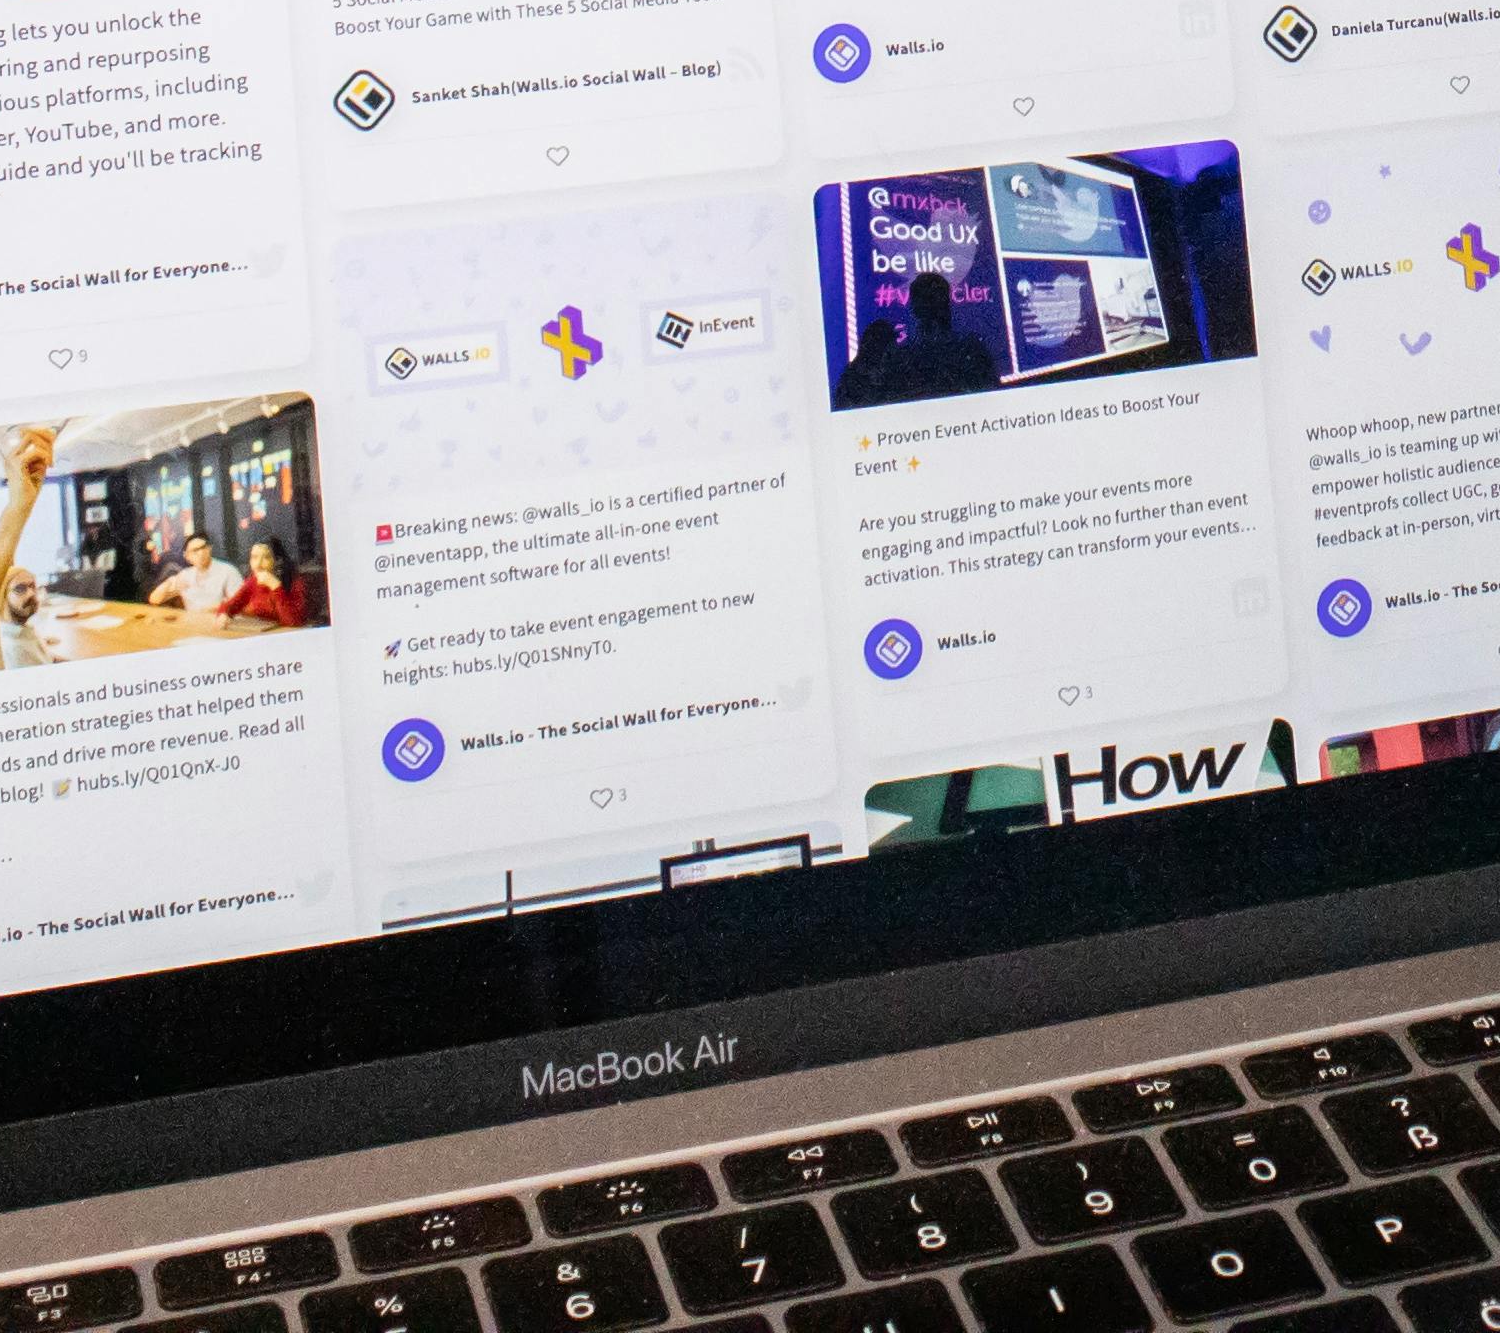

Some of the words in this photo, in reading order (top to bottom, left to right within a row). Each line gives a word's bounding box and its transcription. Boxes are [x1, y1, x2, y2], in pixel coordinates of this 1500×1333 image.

[11, 23, 48, 42] lets
[52, 21, 89, 43] you
[95, 10, 164, 34] unlock
[168, 8, 202, 27] the
[885, 38, 945, 57] Walls.io
[412, 87, 467, 104] Sanket
[470, 75, 578, 98] Shah(Walls.io
[582, 69, 629, 87] Social
[632, 66, 666, 82] Wall
[681, 60, 722, 79] Blog)
[870, 216, 942, 242] Good
[948, 223, 979, 245] UX
[872, 249, 907, 273] be
[915, 250, 955, 273] like
[700, 316, 755, 334] InEvent
[1305, 424, 1358, 442] Whoop
[1360, 416, 1414, 434] whoop,
[1417, 411, 1447, 426] new
[383, 665, 448, 686] heights:
[1054, 742, 1247, 824] How
[522, 1041, 685, 1099] MacBook
[693, 1033, 739, 1069] Air
[1317, 1065, 1347, 1080] F10
[1153, 1100, 1175, 1113] F9
[980, 1133, 1004, 1146] F8
[803, 1167, 824, 1181] F7
[619, 1202, 643, 1216] F6
[1084, 1190, 1114, 1216] 9
[917, 1225, 947, 1250] 8
[1374, 1216, 1403, 1244] P
[431, 1237, 455, 1250] F5
[741, 1258, 767, 1284] 7
[1211, 1250, 1245, 1278] O
[236, 1272, 262, 1285] F4
[37, 1310, 62, 1323] F3
[565, 1292, 595, 1320] 6
